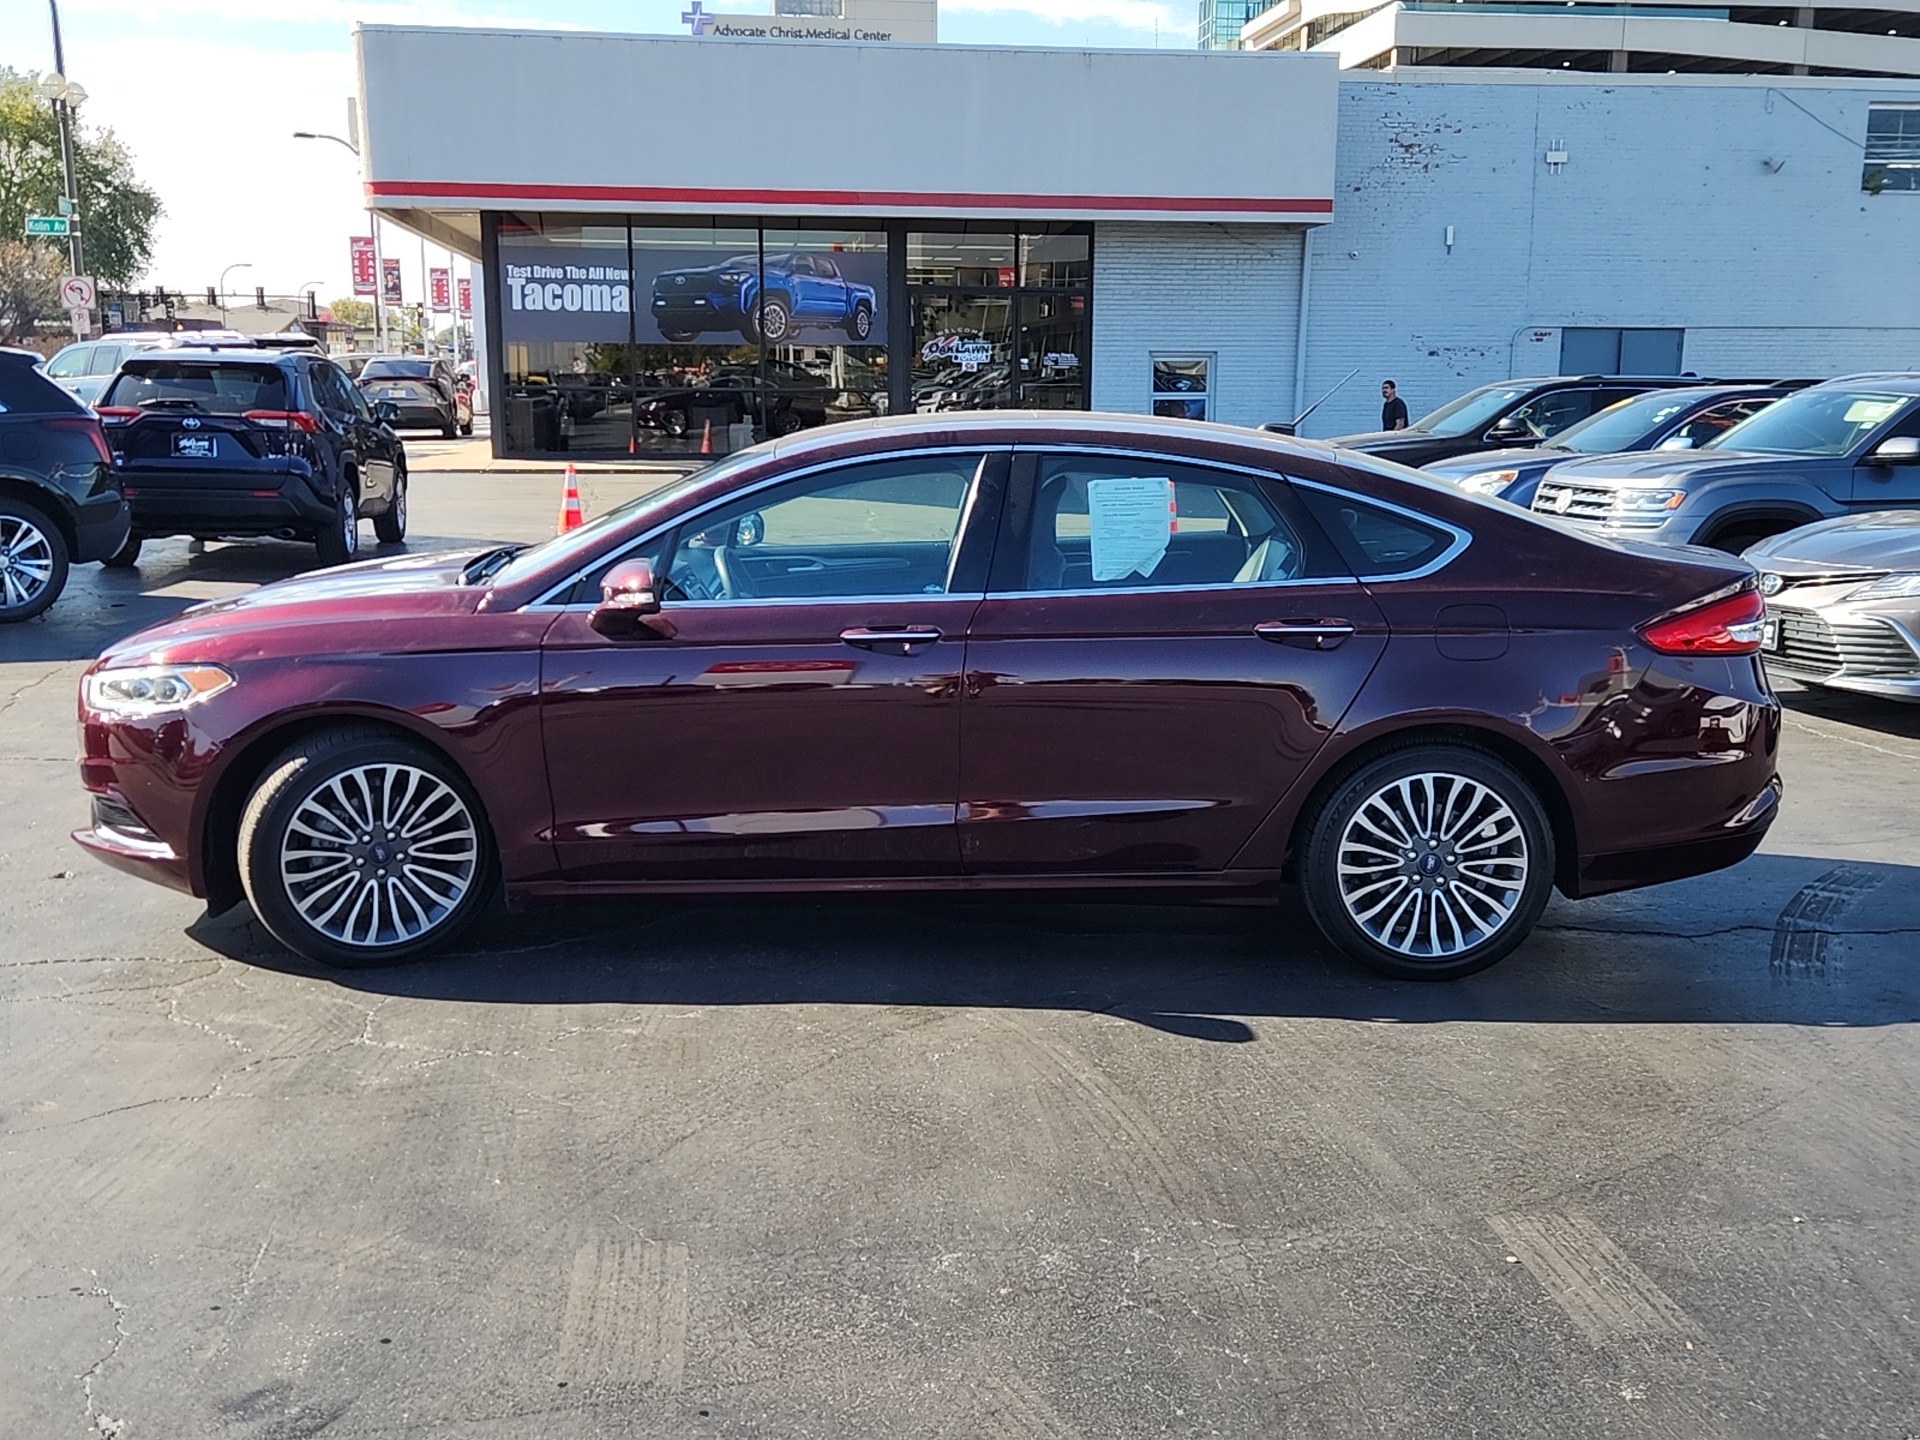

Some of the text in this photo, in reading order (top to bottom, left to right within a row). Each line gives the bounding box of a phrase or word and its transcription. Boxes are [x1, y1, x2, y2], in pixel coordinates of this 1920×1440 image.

[713, 24, 892, 41] Advocate Christ Medical Center
[53, 221, 65, 231] Av
[352, 251, 362, 283] USED
[367, 251, 375, 283] CARS
[506, 265, 635, 280] Test Drive The All New
[506, 278, 636, 313] Tacoma
